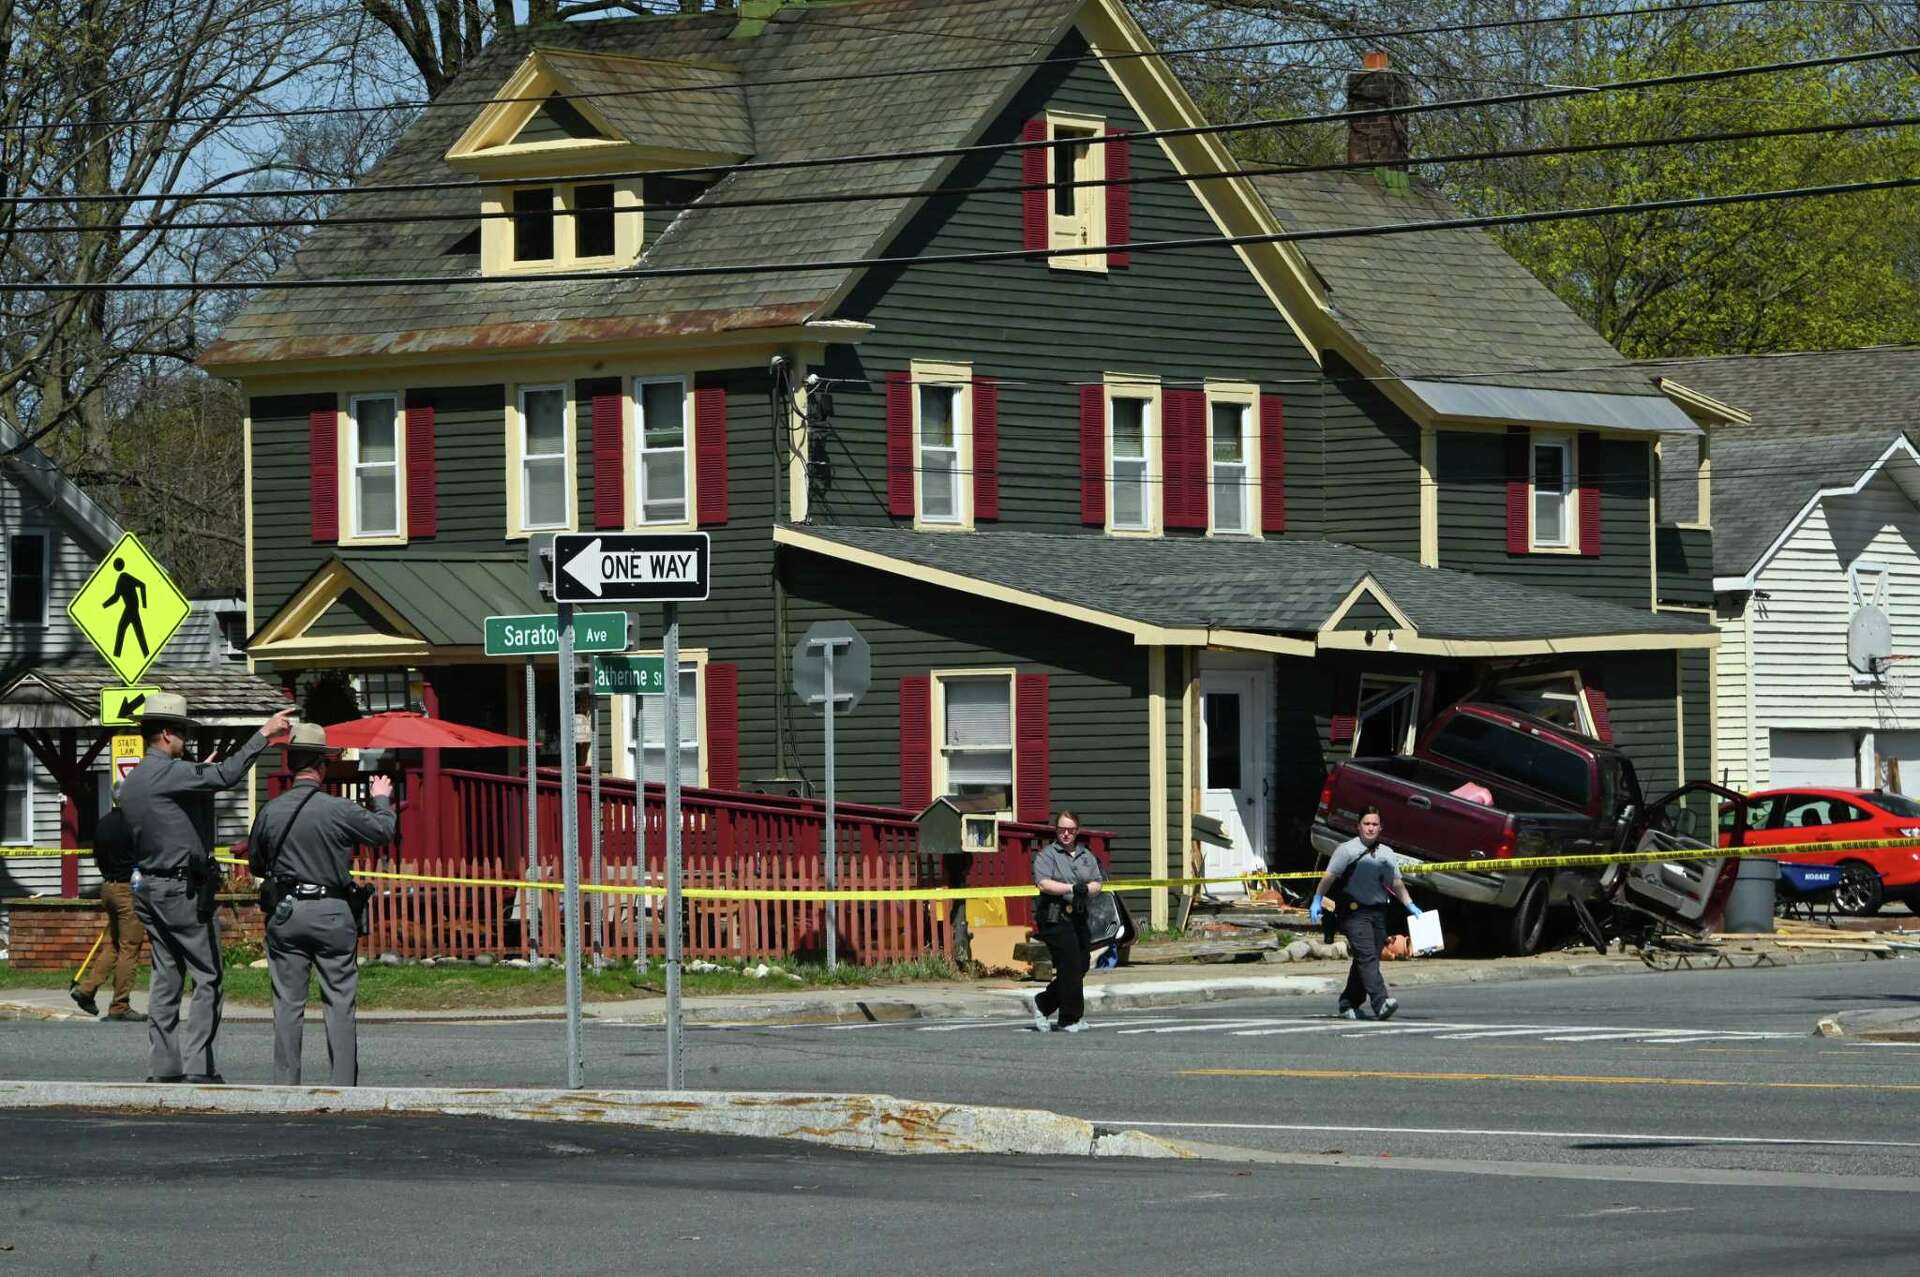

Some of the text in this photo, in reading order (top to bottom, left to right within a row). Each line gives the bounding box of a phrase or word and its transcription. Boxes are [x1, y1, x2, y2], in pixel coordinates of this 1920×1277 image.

[601, 554, 692, 580] ONE WAY
[504, 624, 608, 646] Sarato Ave
[117, 738, 137, 747] STATE
[120, 747, 135, 756] LAW
